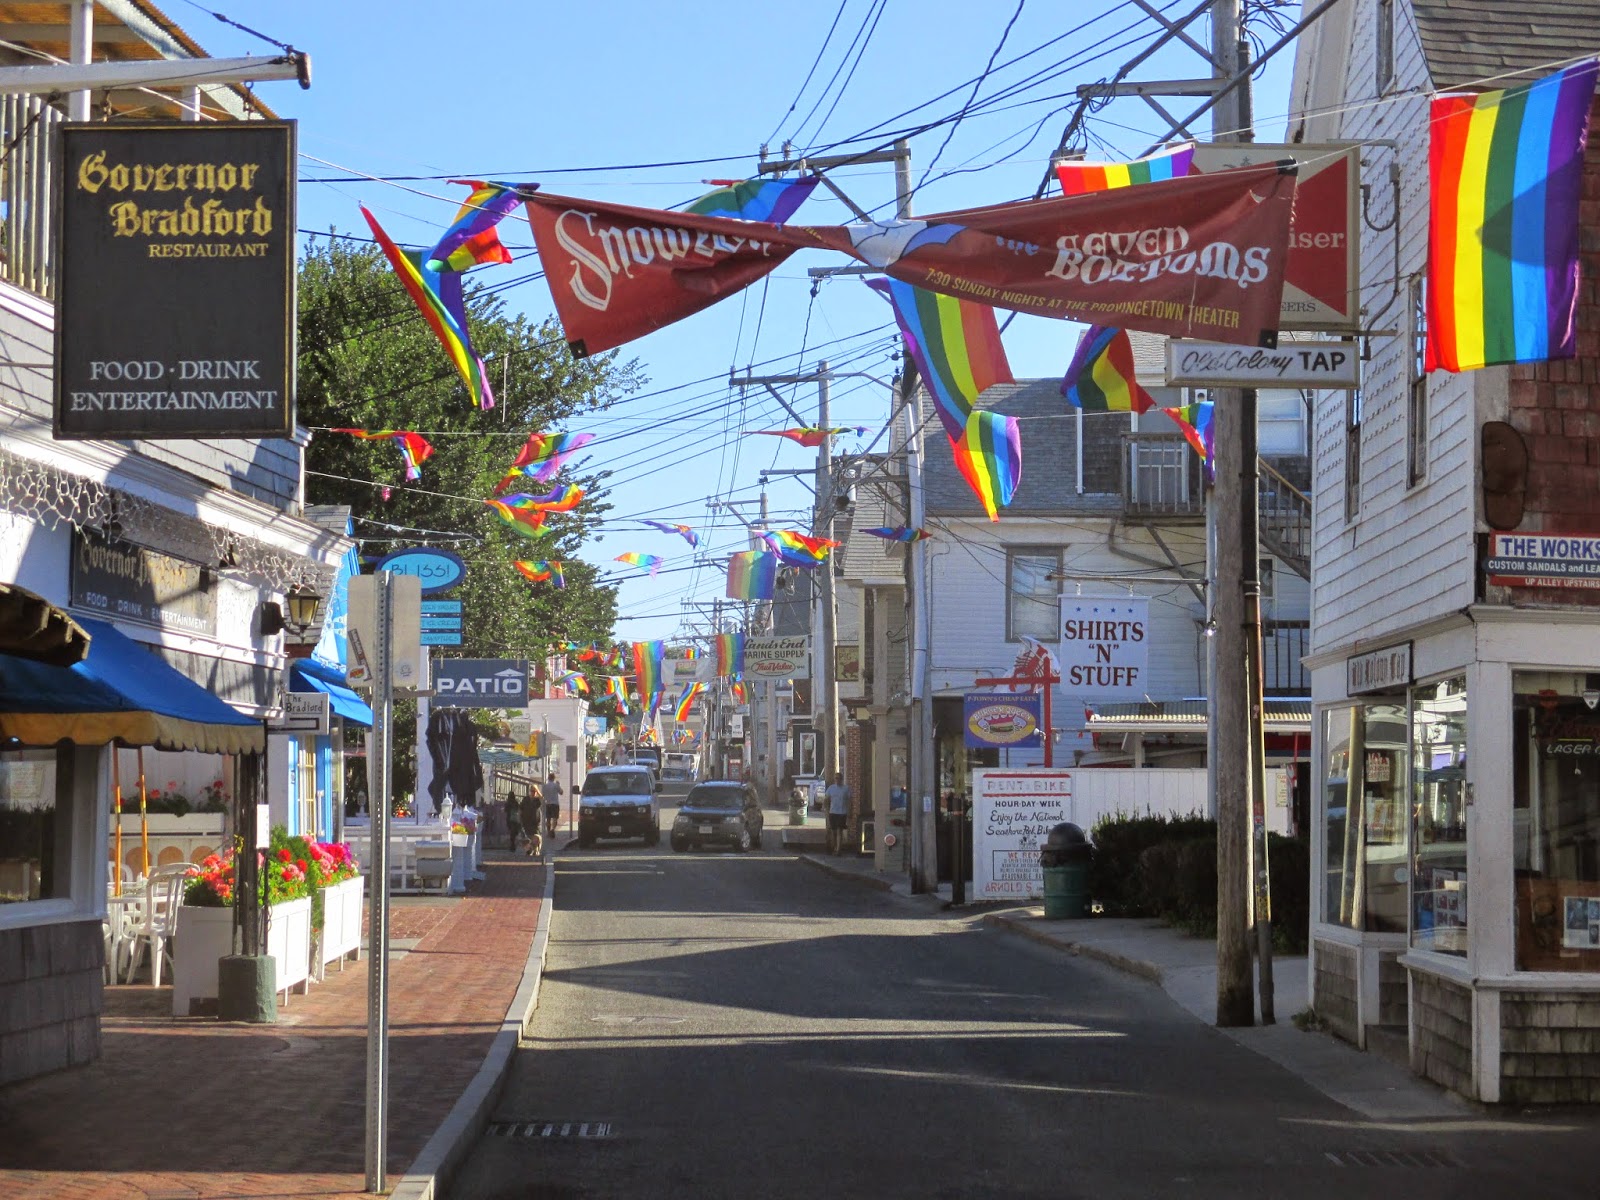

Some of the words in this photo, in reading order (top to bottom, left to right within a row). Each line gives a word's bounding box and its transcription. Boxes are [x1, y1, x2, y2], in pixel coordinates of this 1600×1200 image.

[77, 150, 260, 193] Governor
[109, 196, 273, 237] Bradford
[1055, 226, 1190, 256] SEVEN
[1288, 228, 1344, 248] iser
[149, 243, 269, 258] RESTAURANT
[1045, 242, 1271, 288] BOTTOMS
[925, 267, 951, 287] 7:30
[952, 277, 1000, 298] SUNDAY
[1001, 291, 1046, 307] NIGHTS
[1048, 299, 1064, 308] AT
[1067, 301, 1089, 311] THE
[1090, 300, 1185, 321] PROVINCETOWN
[1188, 305, 1240, 329] THEATER
[1280, 301, 1316, 313] EERS
[90, 361, 165, 380] FOOD
[179, 360, 260, 380] DRINK
[1181, 350, 1223, 373] Old
[1223, 350, 1294, 376] Colony
[1299, 351, 1346, 371] TAP
[70, 391, 278, 411] ENTERTAINMENT
[1500, 538, 1537, 557] THE
[1488, 560, 1525, 571] CUSTOM
[1526, 562, 1566, 572] SANDALS
[1568, 564, 1584, 573] and
[1585, 565, 1600, 574] LEA
[1537, 579, 1561, 587] ALLEY
[86, 592, 108, 607] FOOD
[117, 600, 143, 616] DRINK
[151, 607, 207, 630] ENTERTAINMENT
[1064, 619, 1144, 641] SHIRTS
[744, 638, 779, 650] Lands
[780, 638, 806, 649] End
[774, 650, 805, 659] SUPPLY
[772, 662, 793, 671] Value
[1069, 666, 1139, 686] STUFF
[437, 678, 522, 694] PATIO
[286, 693, 302, 702] The
[286, 700, 323, 712] Bradford
[1546, 744, 1592, 755] LAGER
[1034, 781, 1067, 791] BIKE
[990, 809, 1013, 826] Enjoy
[1014, 812, 1028, 822] the
[1029, 810, 1066, 822] National
